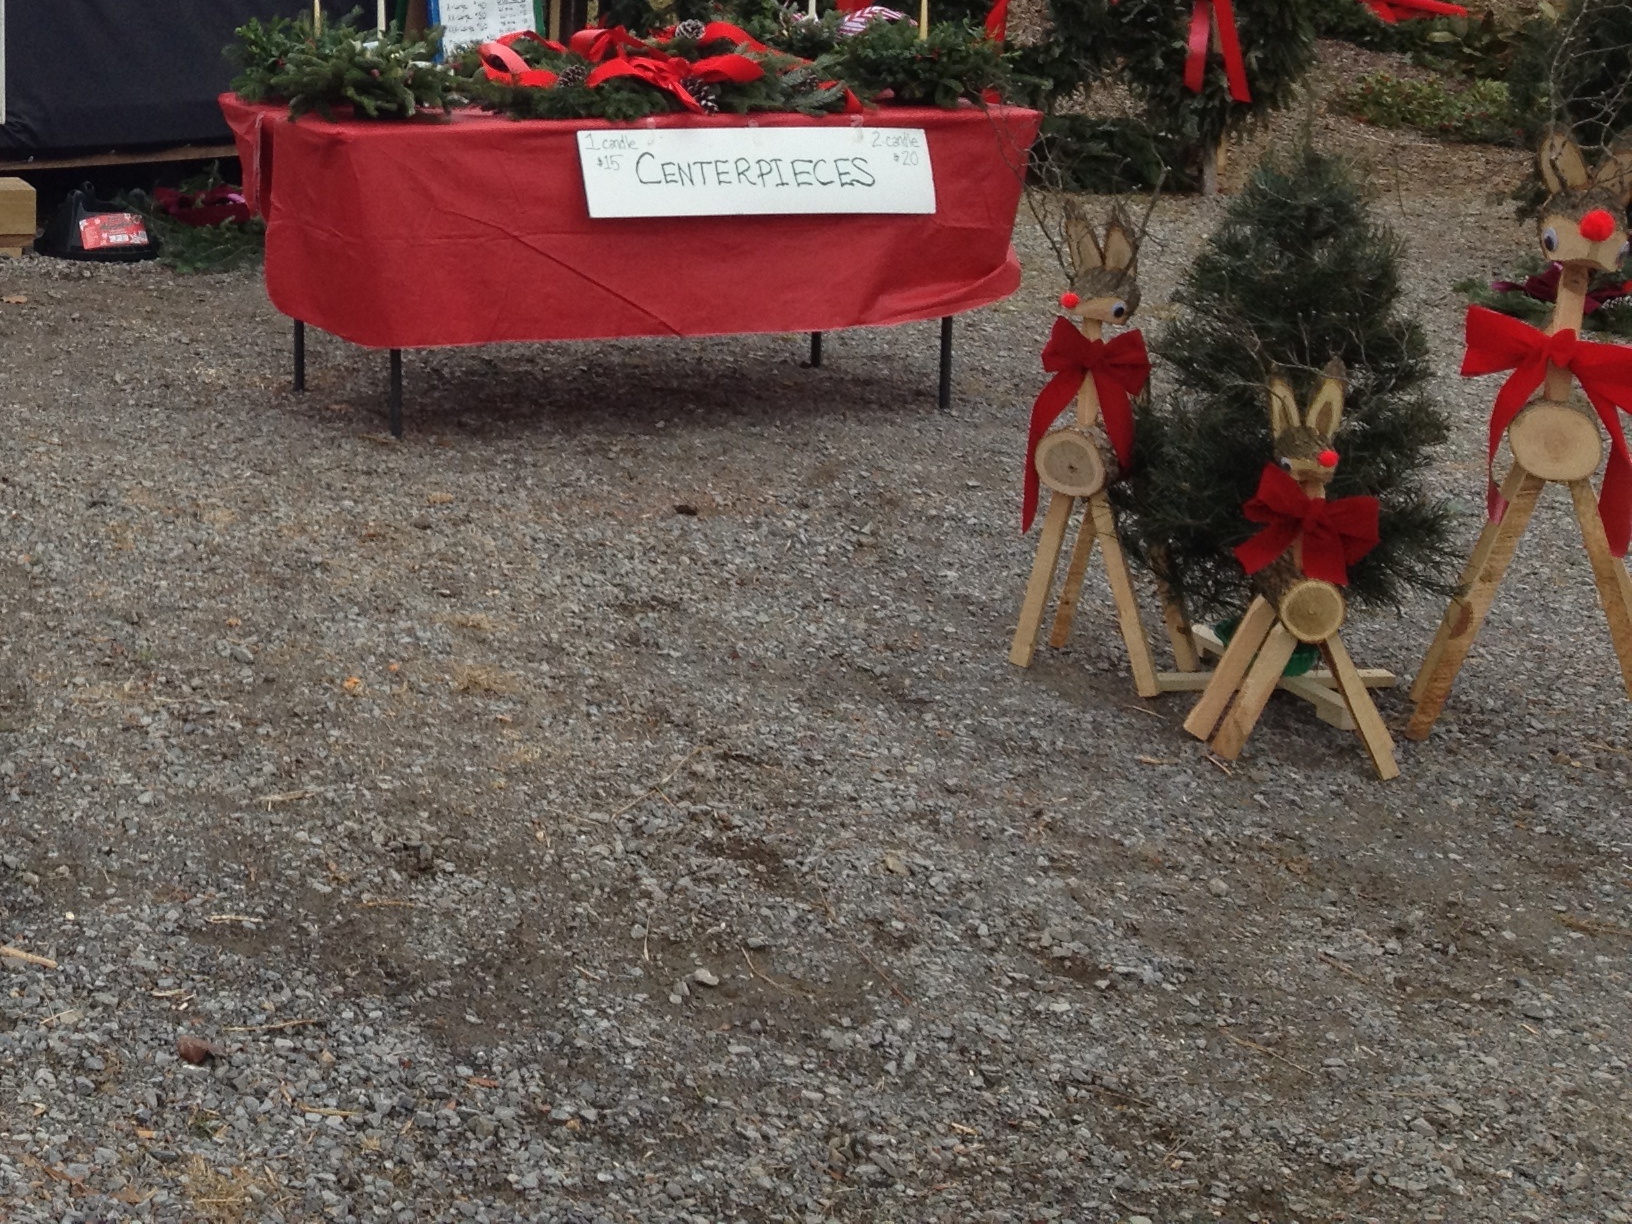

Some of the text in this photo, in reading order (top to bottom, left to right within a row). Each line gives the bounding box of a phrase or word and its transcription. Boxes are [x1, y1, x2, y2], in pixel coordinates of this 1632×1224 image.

[585, 132, 639, 151] 1 candle
[871, 130, 920, 148] 2 candle
[597, 154, 624, 171] $15
[893, 150, 920, 166] $20
[635, 151, 876, 188] CENTERPIECES
